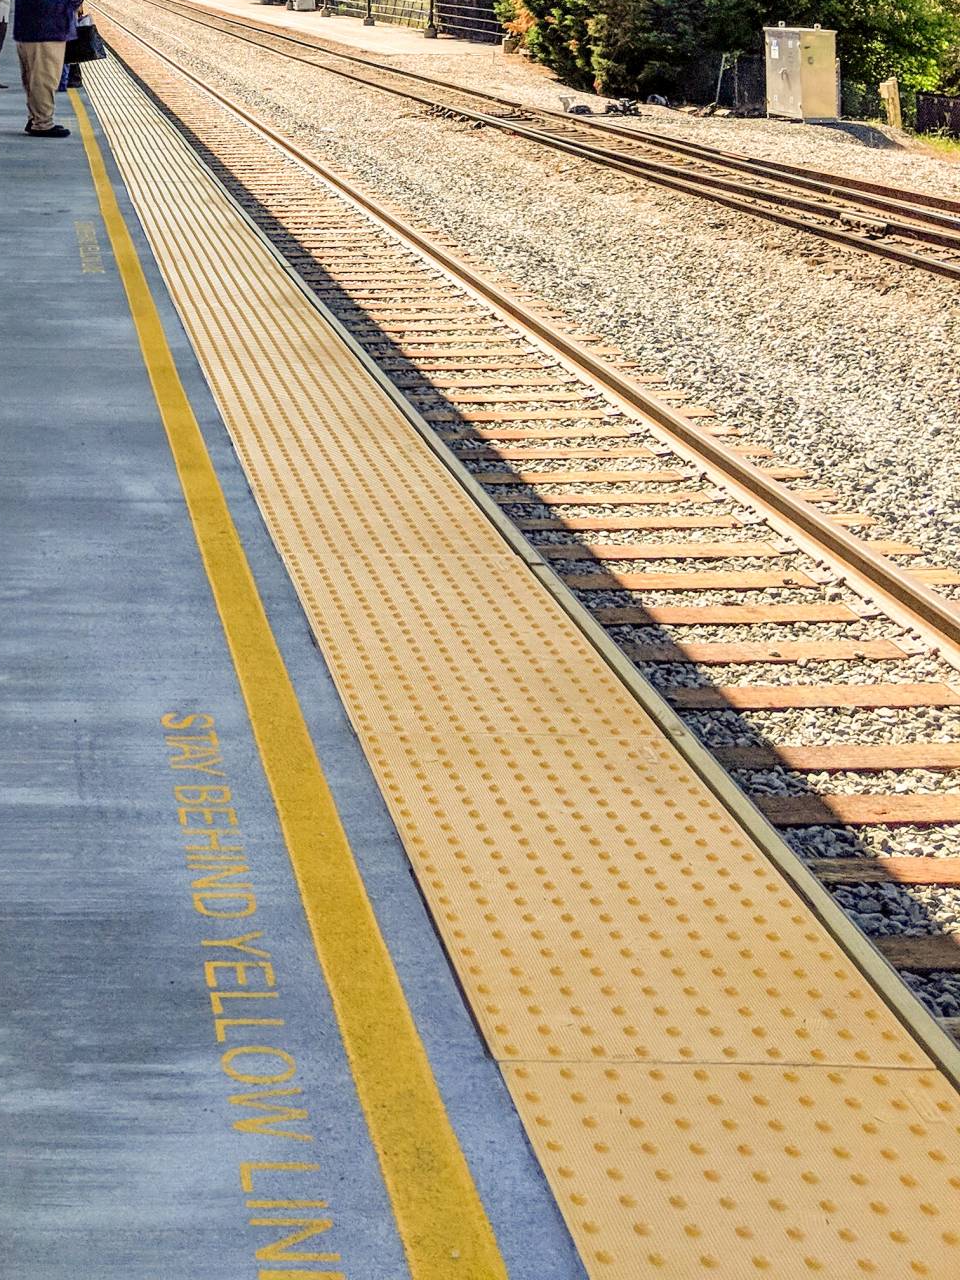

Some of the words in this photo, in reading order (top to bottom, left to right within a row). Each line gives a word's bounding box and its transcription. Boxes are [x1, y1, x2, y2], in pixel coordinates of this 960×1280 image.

[160, 712, 225, 777] STAY
[174, 785, 257, 919] BEHIND
[201, 931, 314, 1142] YELLOW
[240, 1162, 347, 1280] LIN
